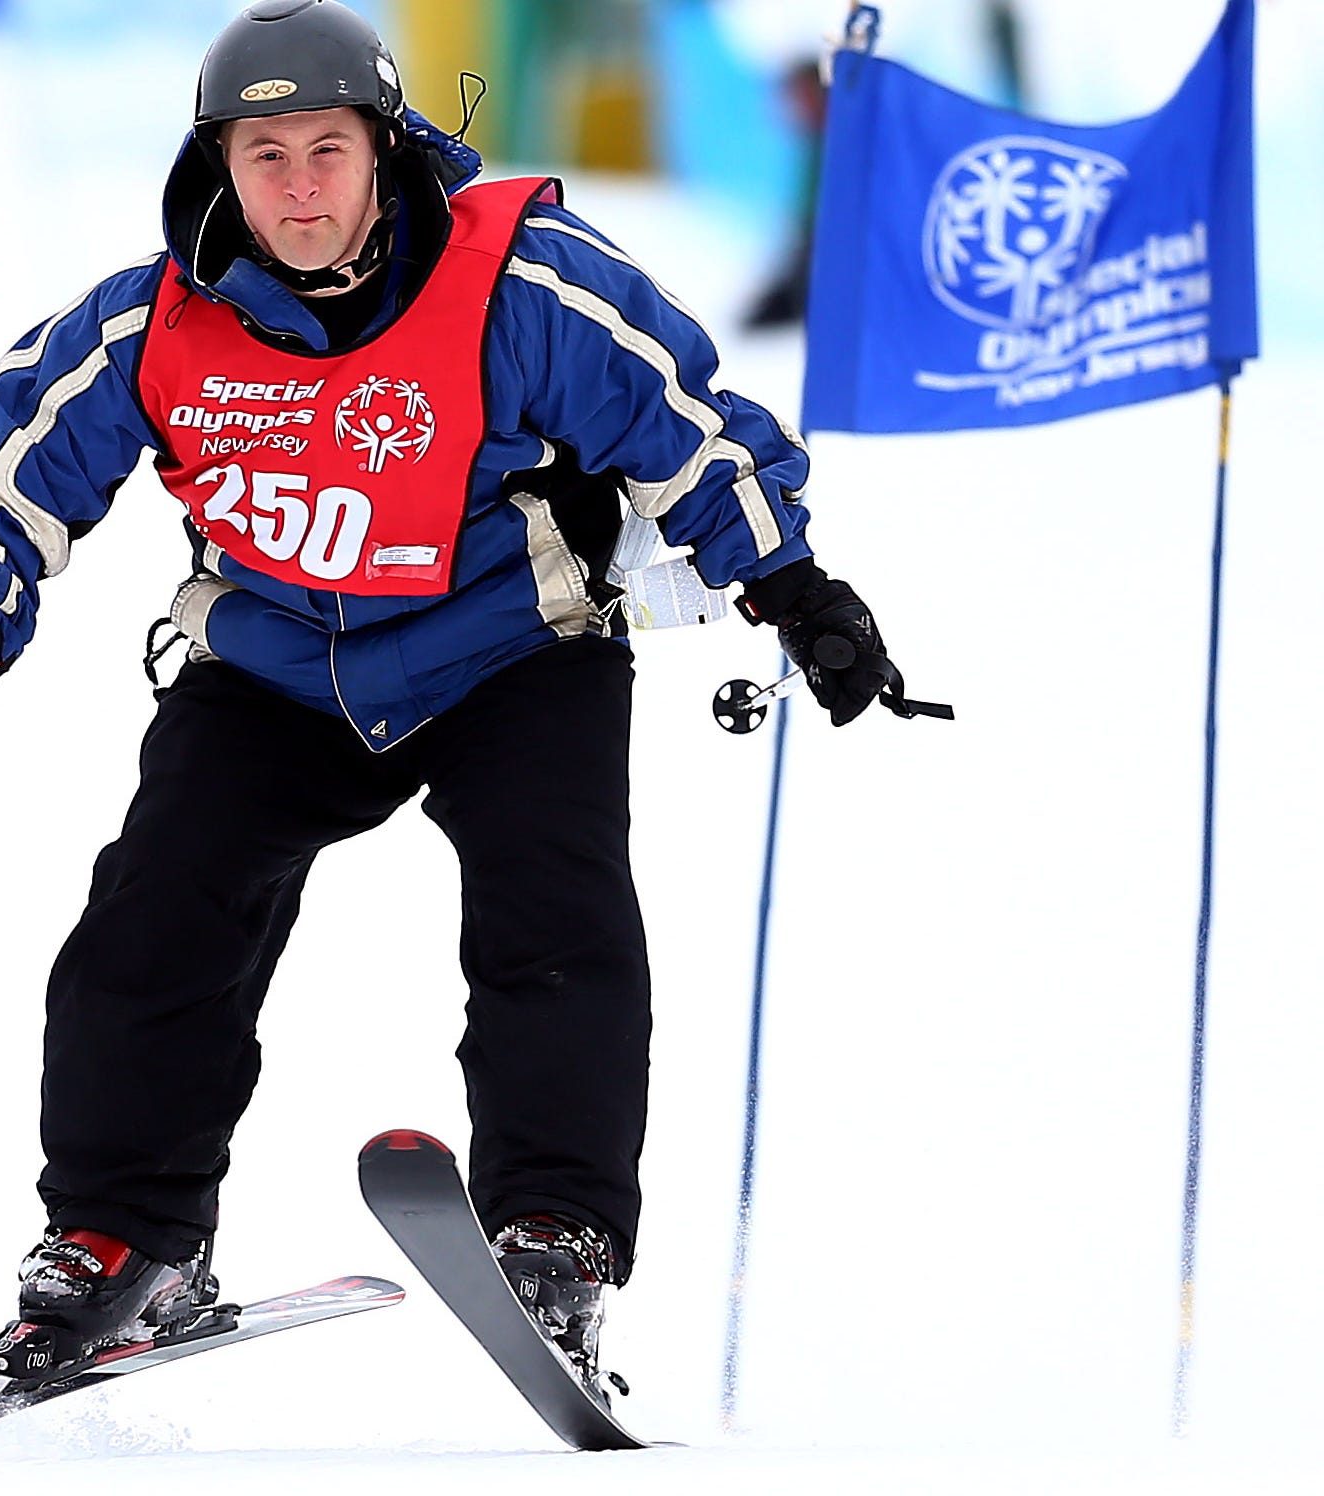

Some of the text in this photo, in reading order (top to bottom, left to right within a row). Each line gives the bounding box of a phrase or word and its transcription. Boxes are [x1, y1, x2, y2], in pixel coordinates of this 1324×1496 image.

[1040, 221, 1207, 326] Secial
[200, 376, 325, 404] Special
[169, 405, 316, 434] Olympcs
[200, 436, 245, 456] New
[193, 463, 373, 581] 250
[26, 1352, 51, 1369] (10)
